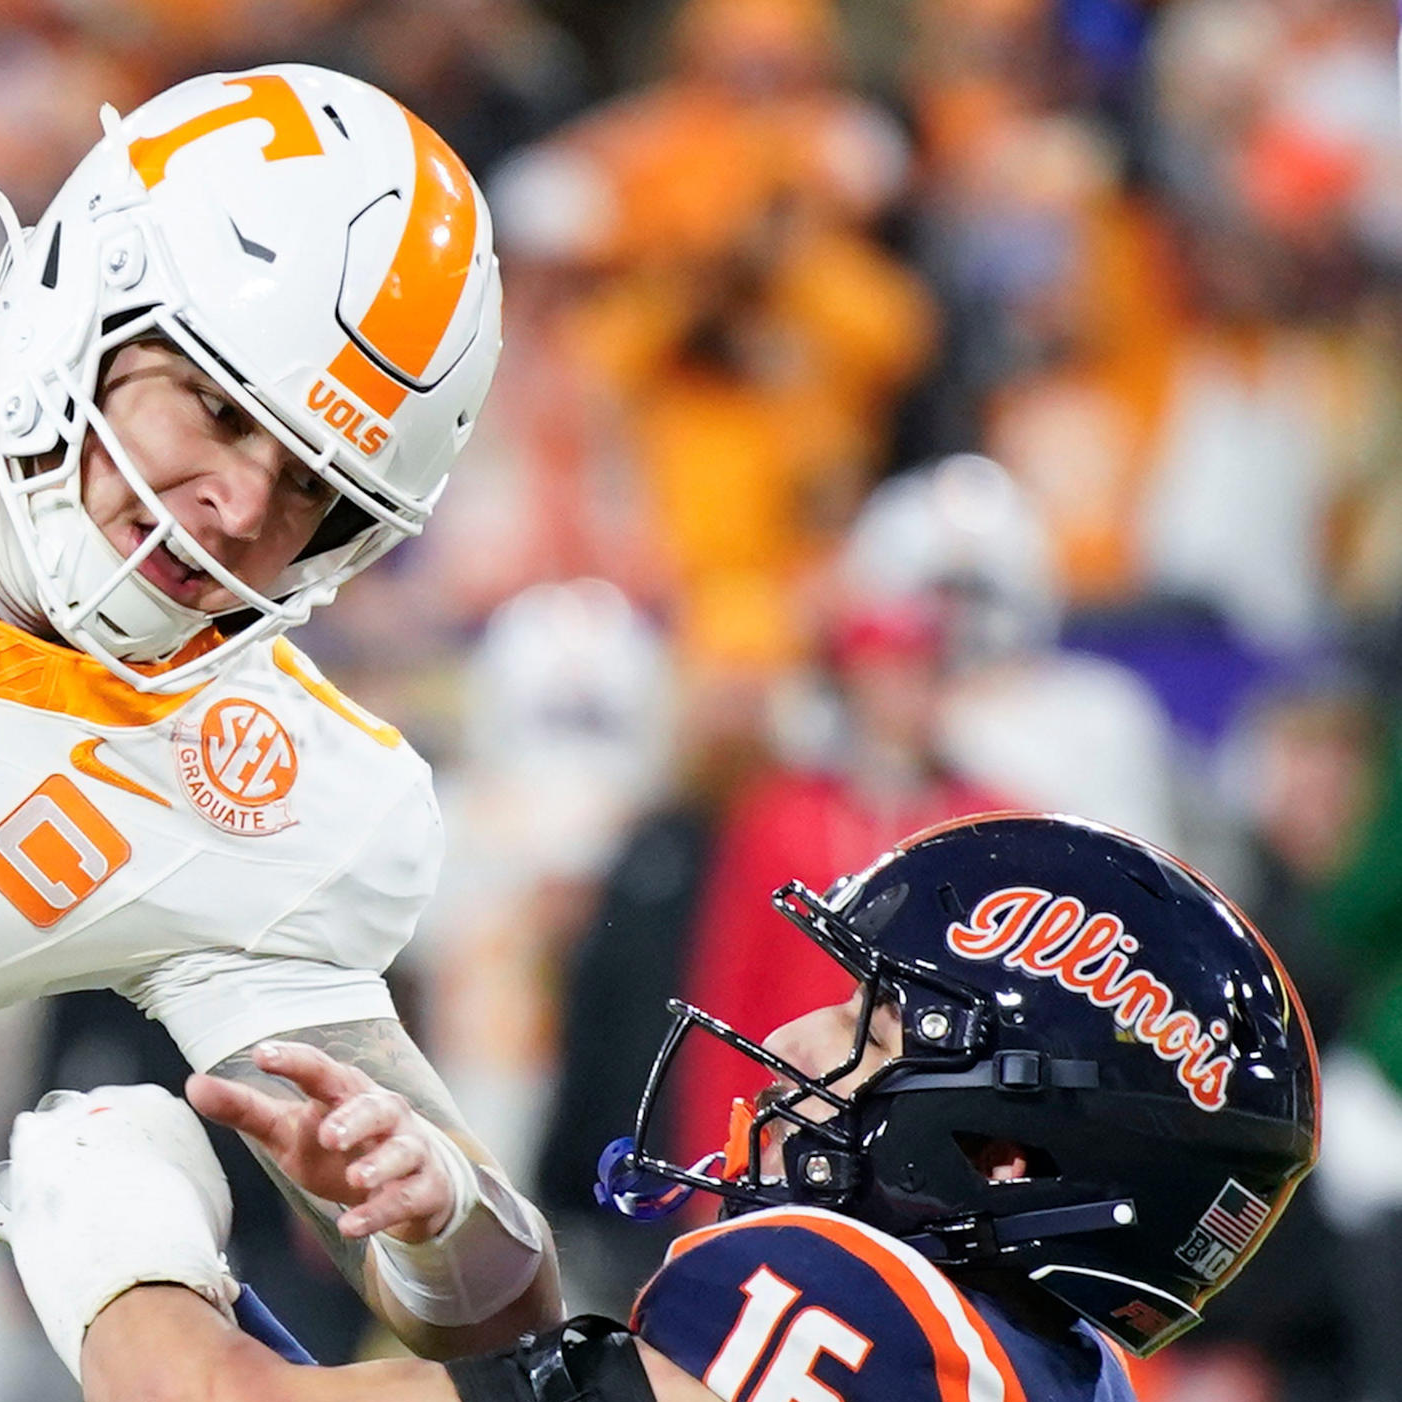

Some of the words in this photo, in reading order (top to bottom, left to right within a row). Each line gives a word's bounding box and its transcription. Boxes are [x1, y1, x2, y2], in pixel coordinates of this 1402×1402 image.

[128, 74, 325, 190] T
[305, 379, 390, 455] VOLS
[180, 747, 267, 830] GRADUATE
[208, 705, 292, 799] SEC
[946, 886, 1233, 1113] Illinois
